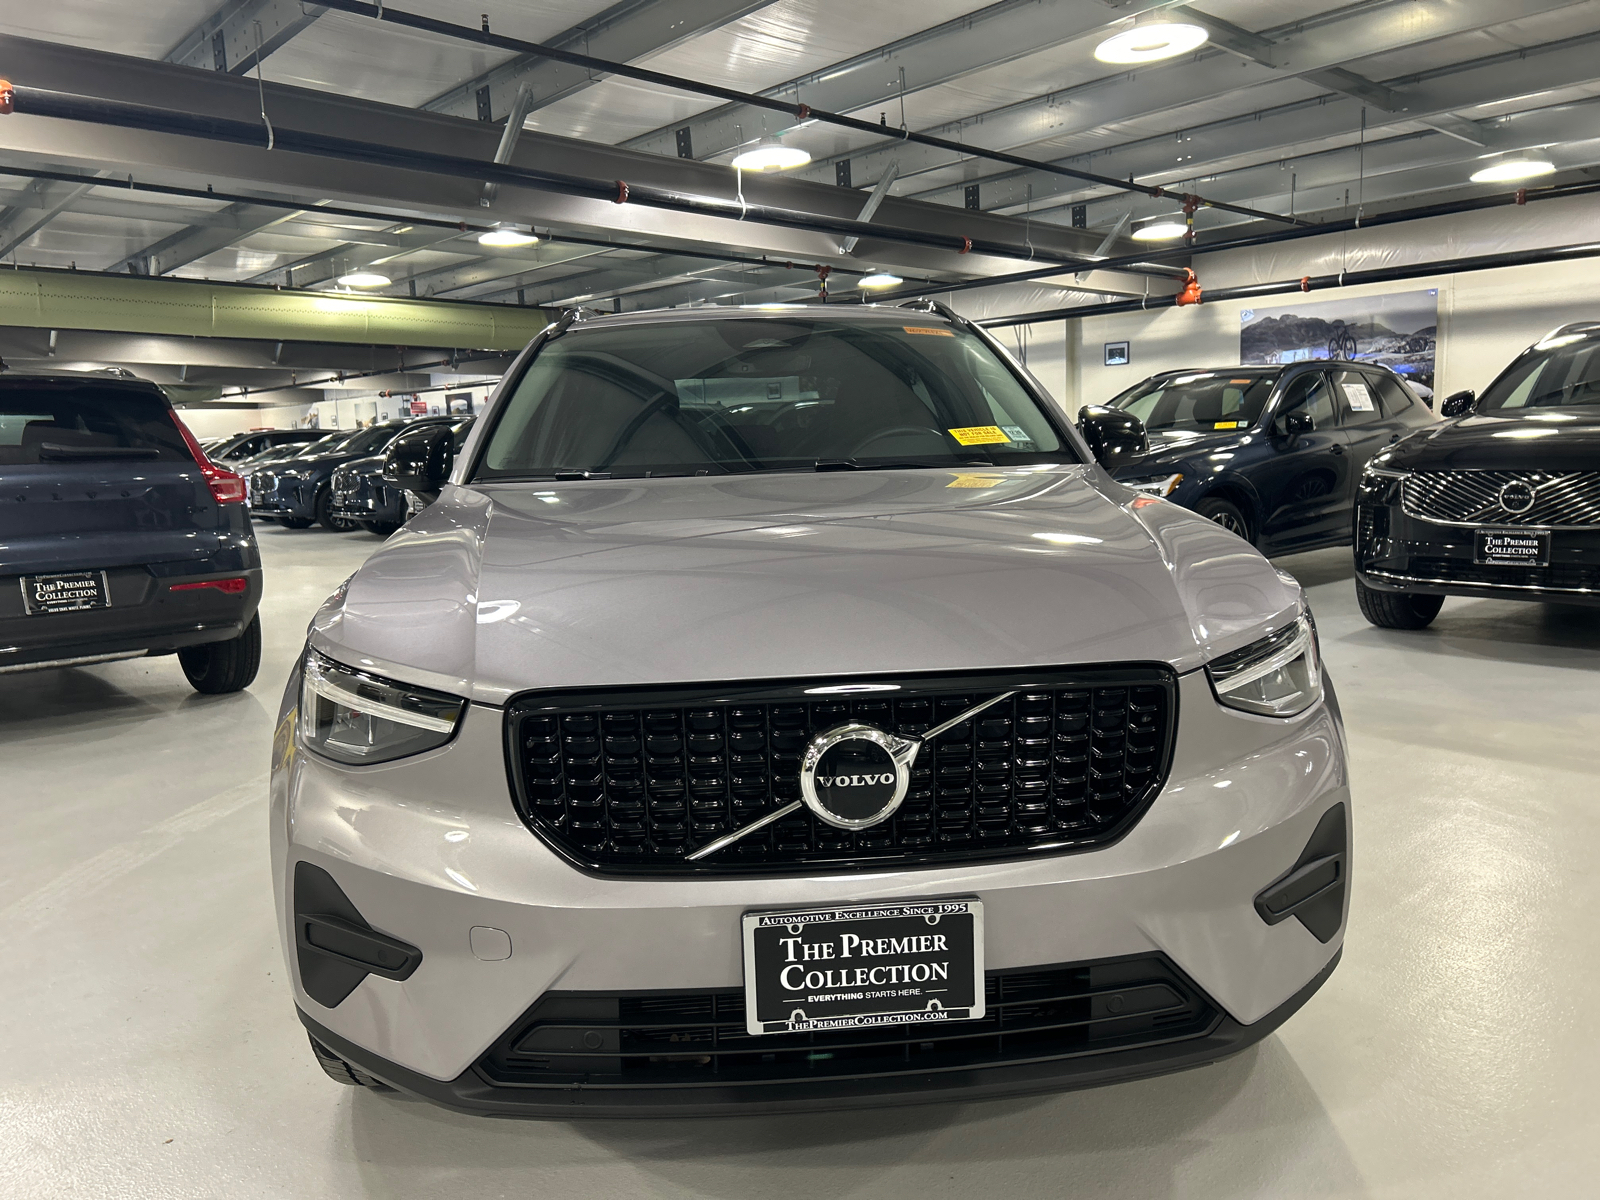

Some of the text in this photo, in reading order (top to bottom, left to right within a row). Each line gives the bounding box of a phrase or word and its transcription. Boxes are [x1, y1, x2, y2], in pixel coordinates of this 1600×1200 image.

[1485, 536, 1538, 546] THE PREMIER
[1485, 544, 1538, 555] COLLECTION
[34, 580, 96, 591] THE PREMIER
[35, 589, 97, 600] COLLECTION
[817, 772, 895, 788] VOLVO
[761, 903, 967, 926] AUTOMOTIVE EXCELLENCE SINCE 1995
[779, 933, 949, 963] THE PREMIER
[779, 961, 949, 991] COLLECTION
[808, 988, 923, 1003] EVERYTHING STARTS HERE.
[785, 1011, 948, 1031] THEPREMIERCOLLECTION.COM
